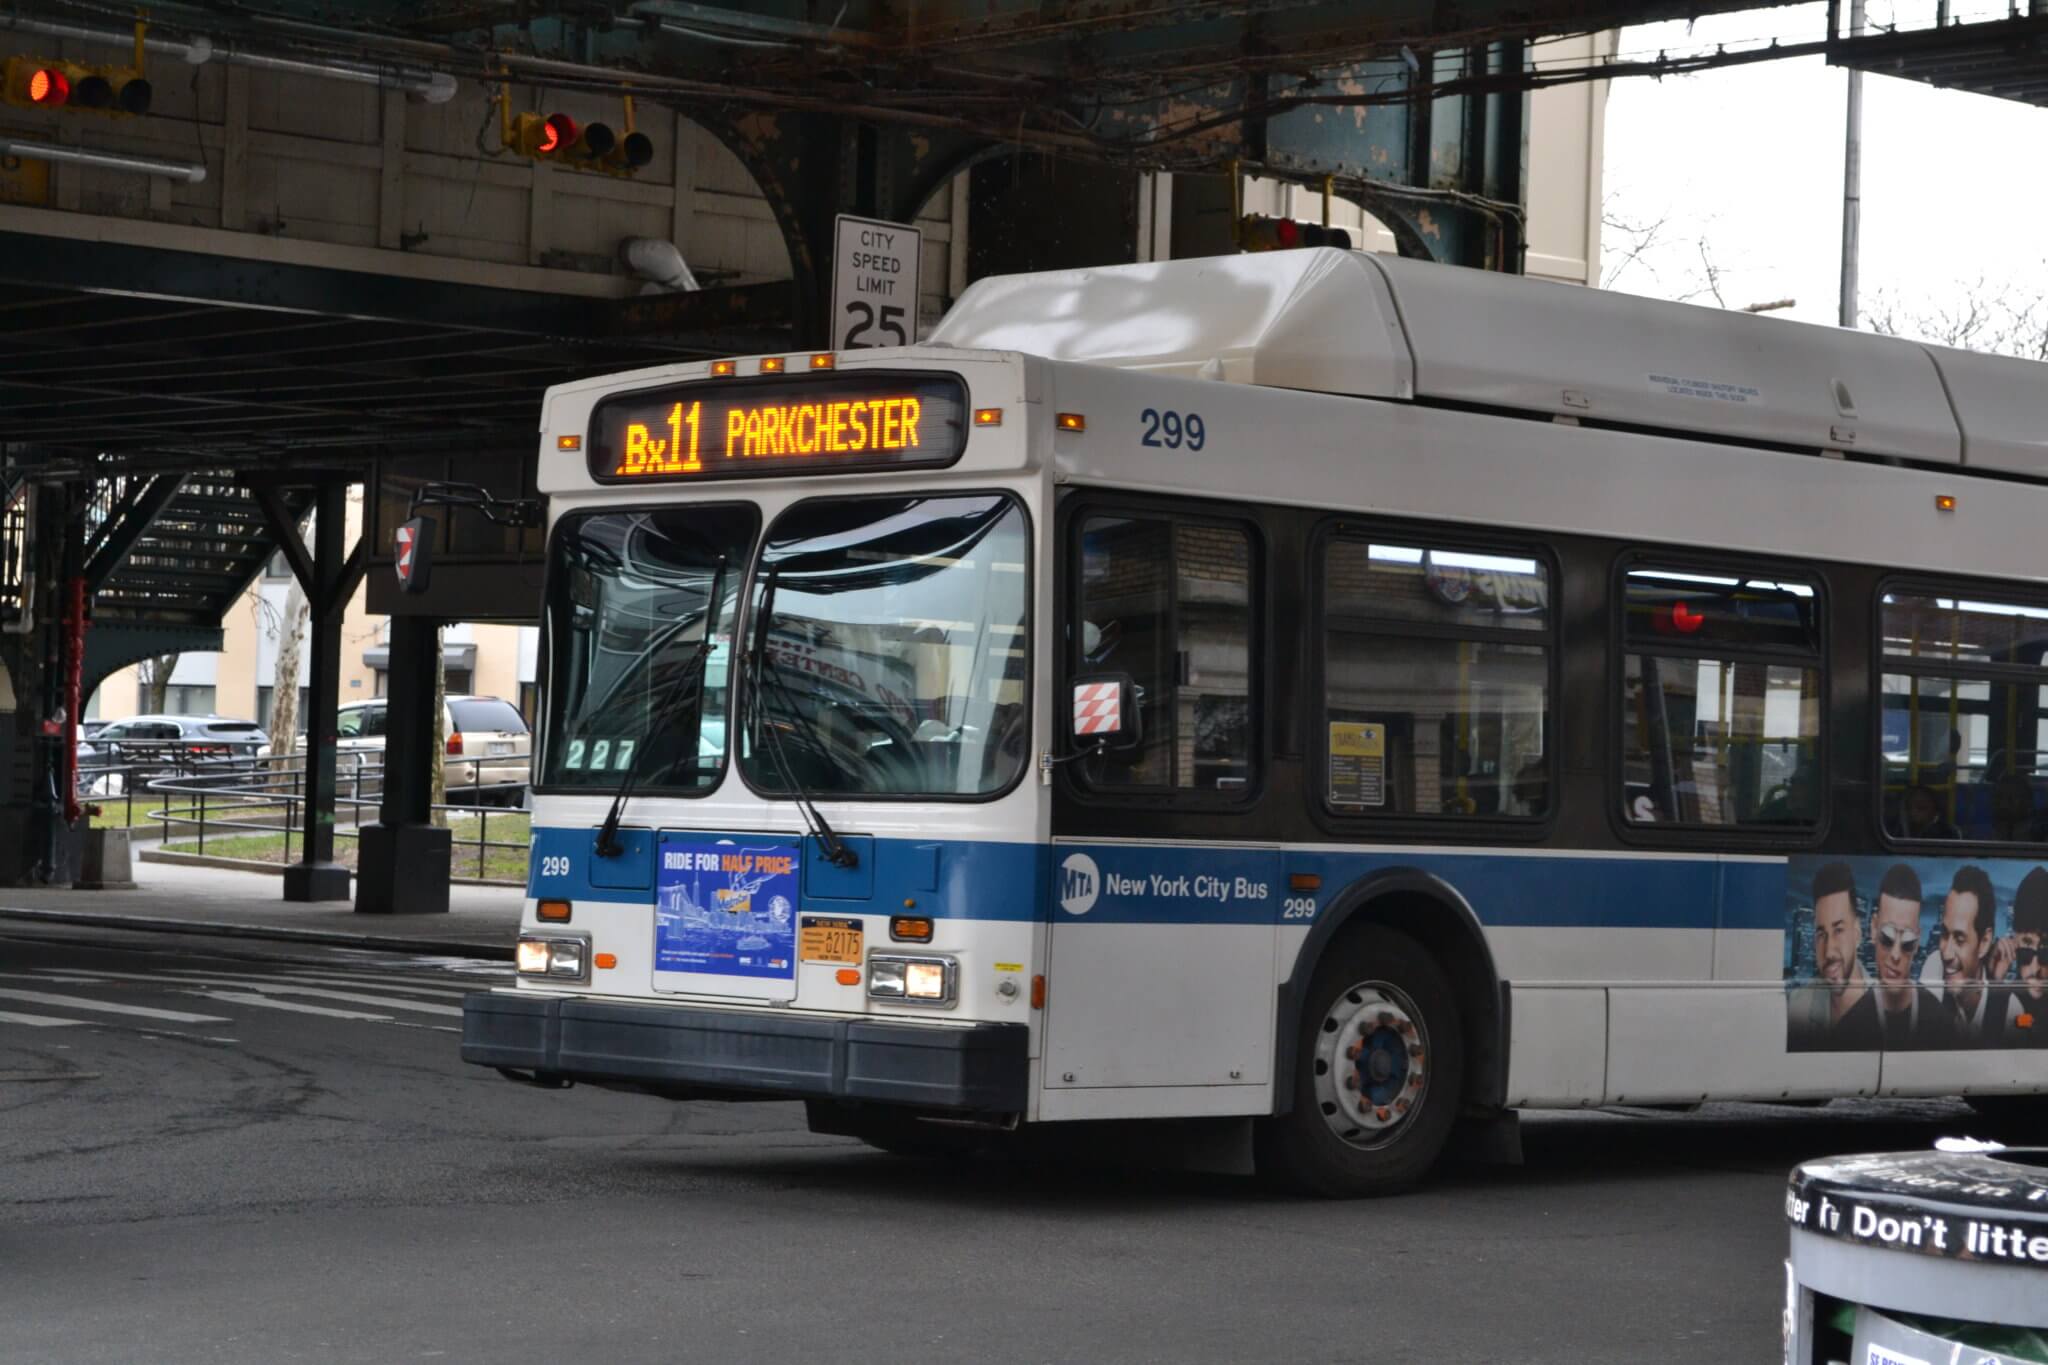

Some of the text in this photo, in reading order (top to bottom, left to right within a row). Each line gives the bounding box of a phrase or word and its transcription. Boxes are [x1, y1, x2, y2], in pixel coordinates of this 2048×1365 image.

[861, 231, 894, 250] CITY
[852, 252, 901, 273] SPEED
[857, 275, 896, 296] LIMIT
[844, 301, 906, 349] 25
[726, 398, 920, 457] PARKCHESTER
[1141, 408, 1205, 452] 299
[541, 856, 570, 877] 299
[664, 852, 792, 874] RIDE FOR HALF PRICE
[1061, 866, 1094, 902] MTA
[1105, 873, 1268, 903] New York City Bus
[1283, 898, 1316, 919] 299
[833, 931, 860, 955] 2175
[1853, 1205, 1948, 1249] Don't
